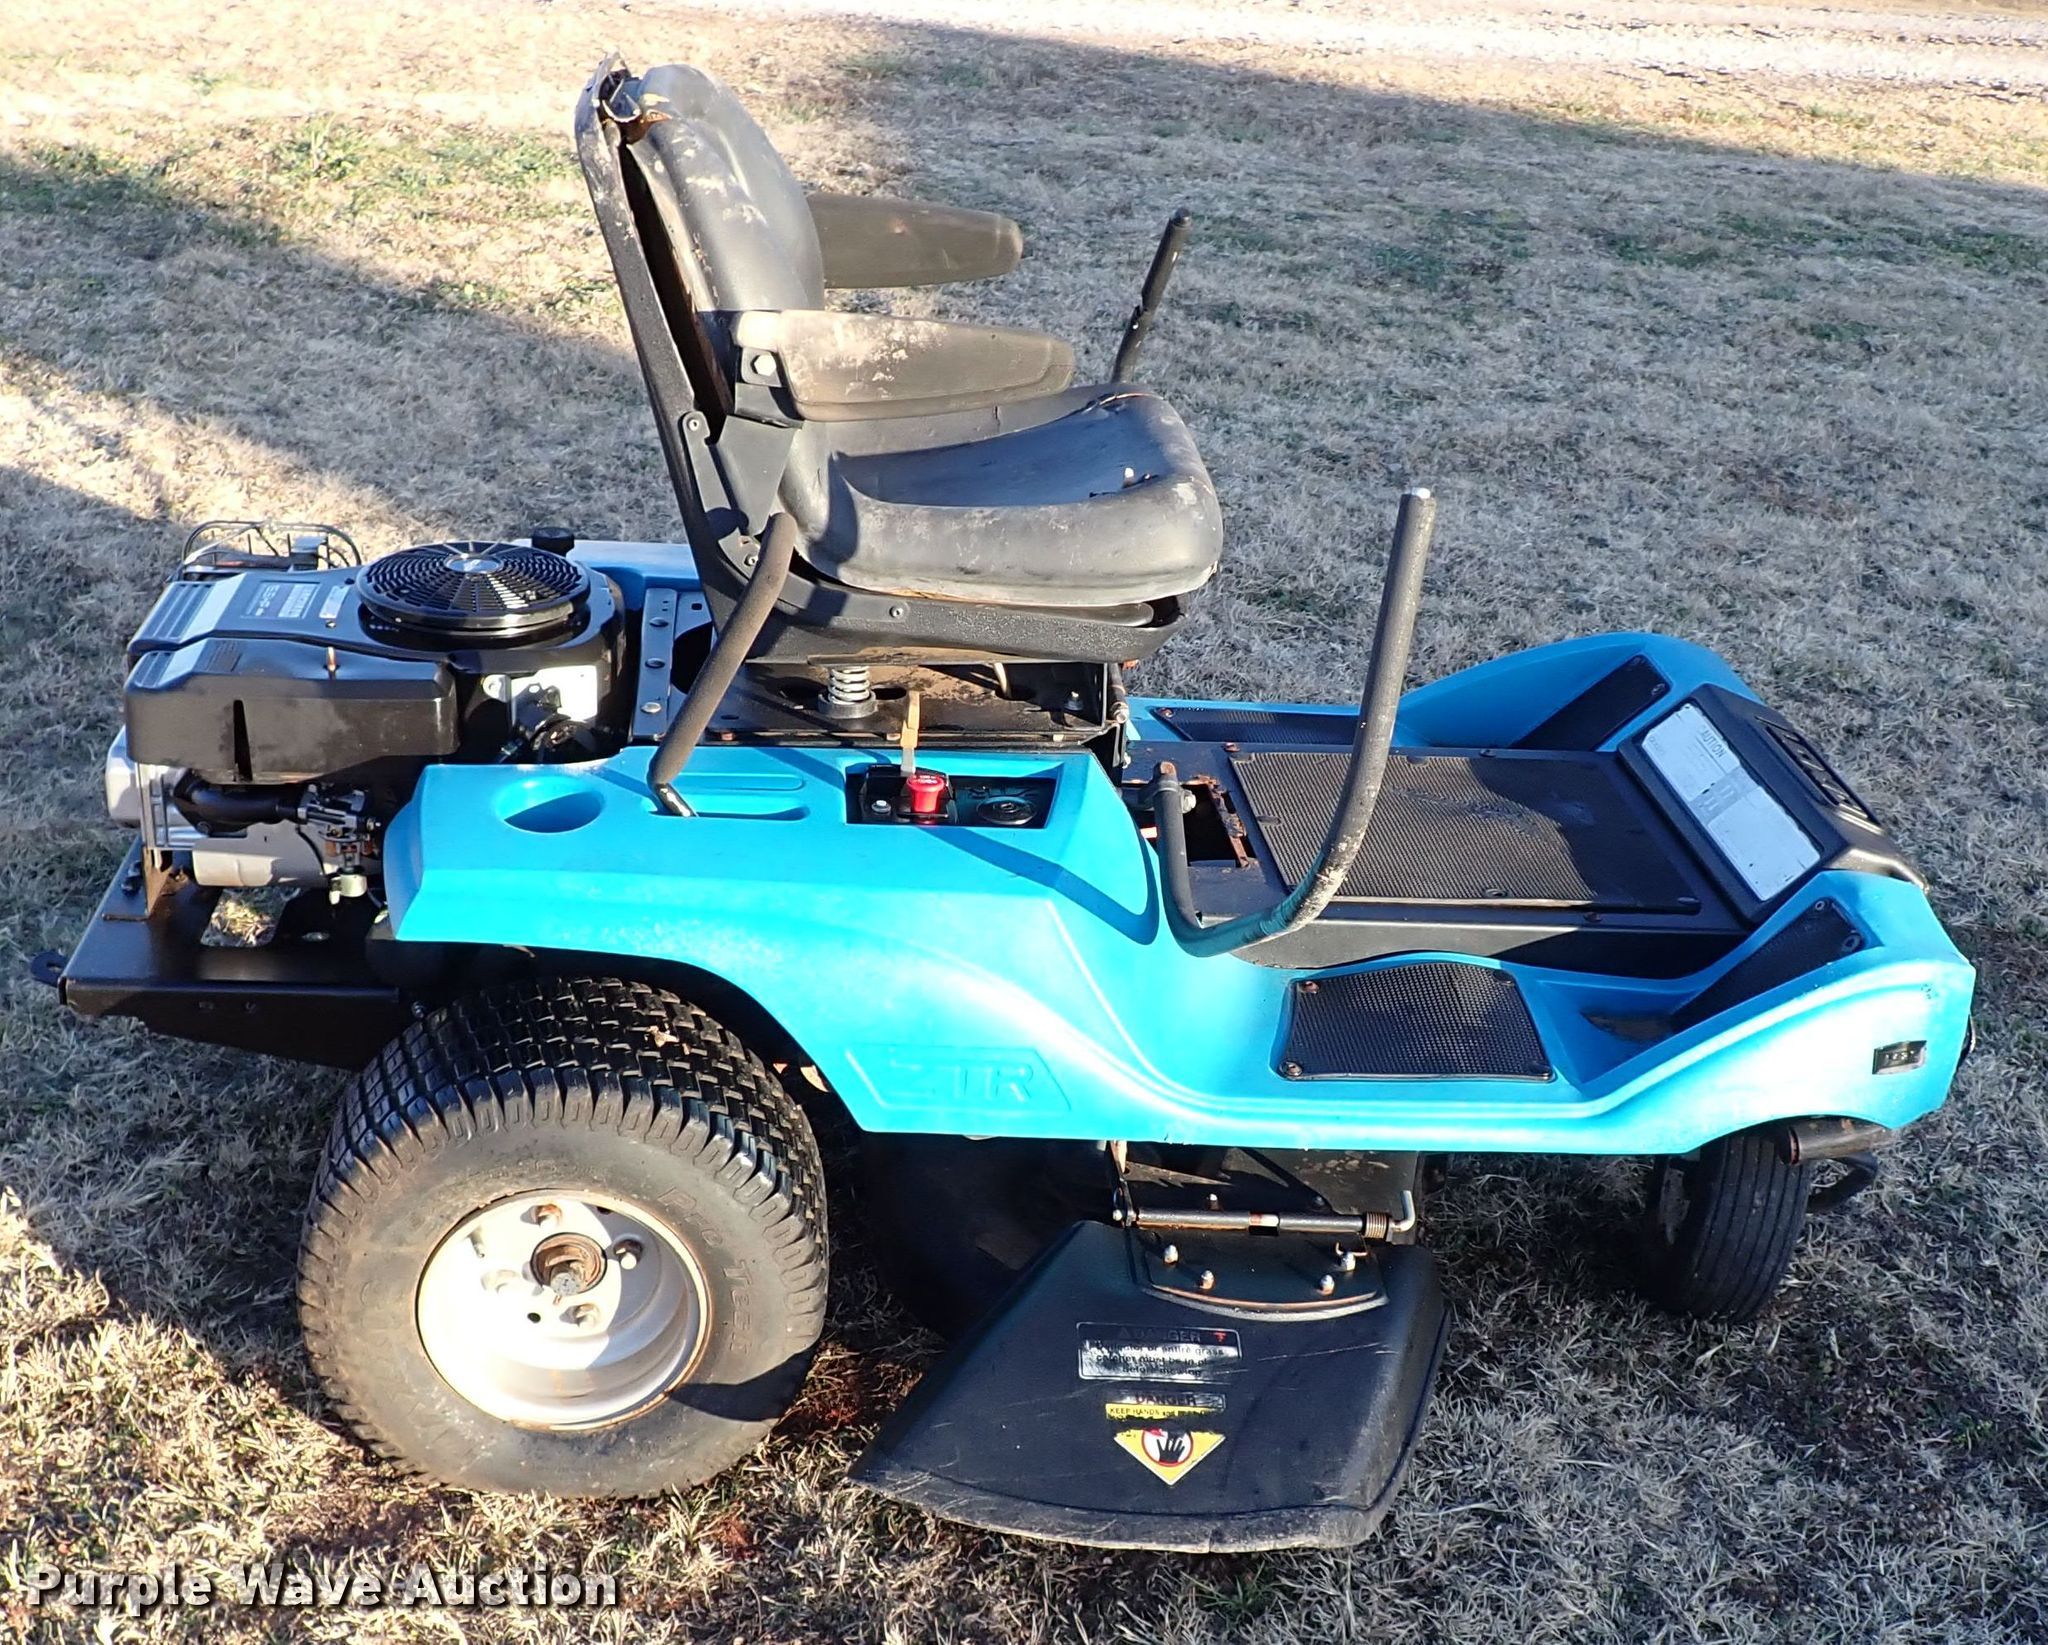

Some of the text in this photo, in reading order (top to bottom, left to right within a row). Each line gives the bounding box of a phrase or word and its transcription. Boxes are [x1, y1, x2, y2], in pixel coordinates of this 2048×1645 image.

[1135, 1328, 1202, 1343] DAGER
[1195, 1346, 1224, 1356] grass
[1109, 1407, 1131, 1415] KEEP
[1132, 1408, 1160, 1416] HANDS
